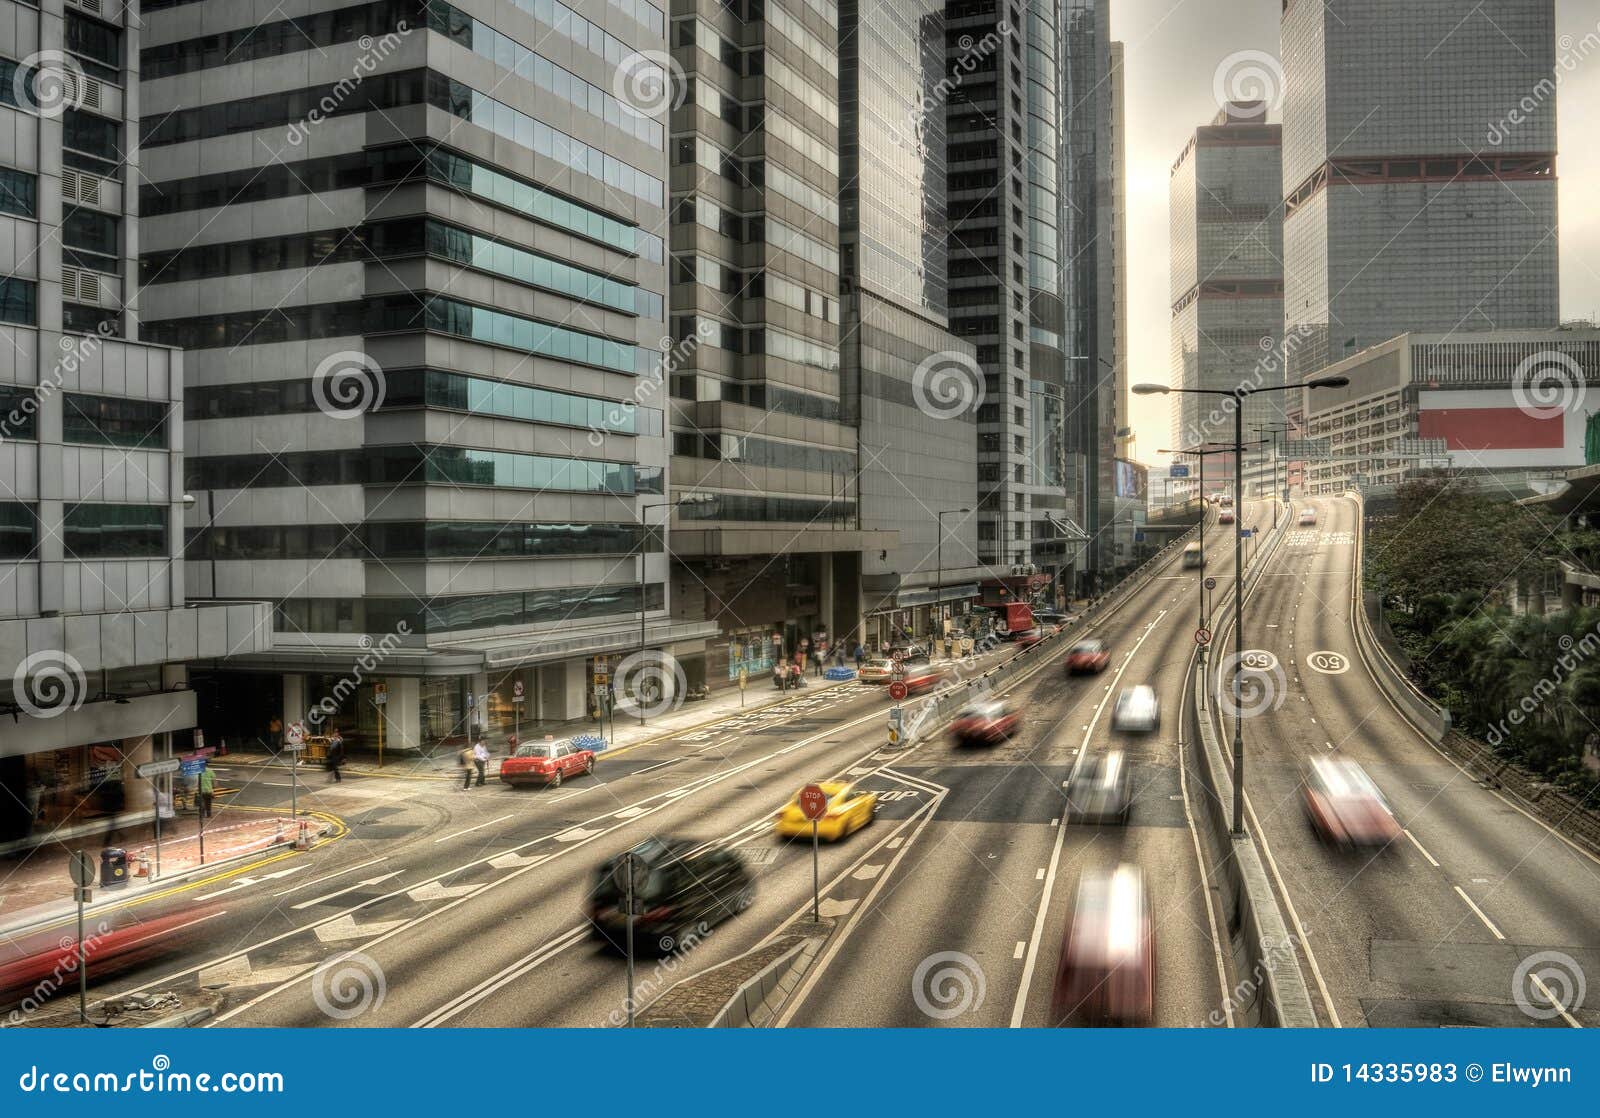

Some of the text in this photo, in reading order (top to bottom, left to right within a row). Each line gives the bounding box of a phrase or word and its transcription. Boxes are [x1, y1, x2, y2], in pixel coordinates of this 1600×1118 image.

[1246, 654, 1269, 666] 50
[1316, 656, 1340, 669] 50
[805, 791, 821, 799] STOP
